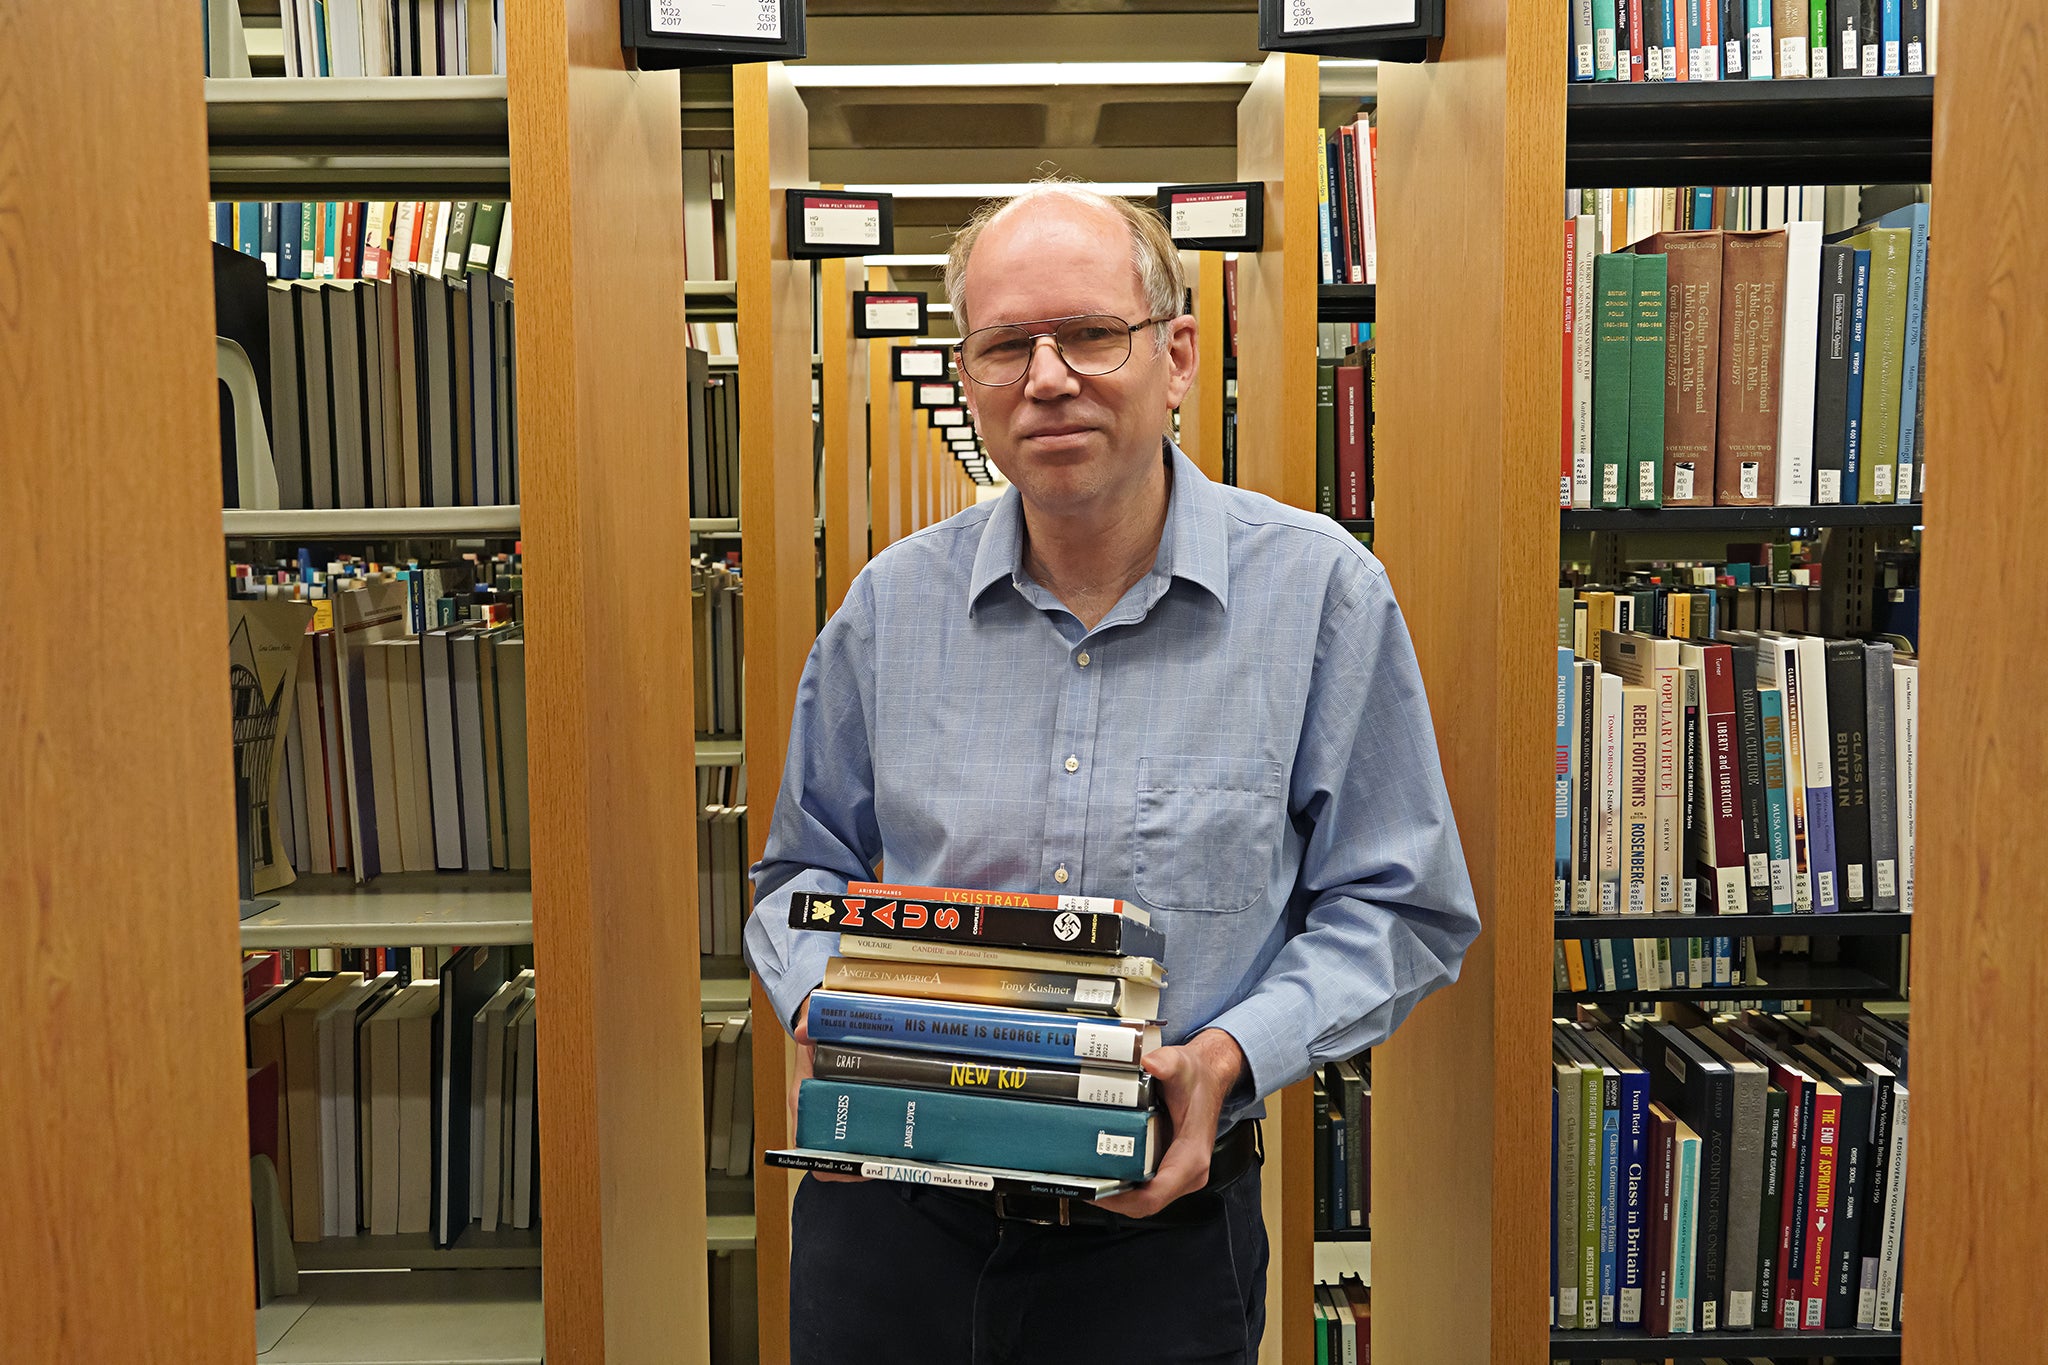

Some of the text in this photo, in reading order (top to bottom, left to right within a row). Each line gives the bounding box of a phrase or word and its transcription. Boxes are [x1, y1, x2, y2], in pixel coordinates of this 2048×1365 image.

[660, 8, 680, 16] M22
[661, 18, 682, 26] 2017
[756, 23, 777, 32] 2017
[758, 14, 777, 22] C58
[762, 6, 776, 14] W5
[1293, 8, 1312, 16] C36
[1293, 17, 1314, 26] 2012
[453, 212, 466, 236] SEX
[1916, 249, 1924, 276] Radical
[1669, 285, 1679, 342] Great Britain
[1734, 284, 1745, 342] Great Britain
[1682, 284, 1696, 392] Public Opinion Polls
[1696, 282, 1710, 414] The Gallup International
[1747, 284, 1762, 391] Public Opinion Polls
[1759, 281, 1775, 414] The Gallup International
[1558, 675, 1566, 727] PILKINGTON
[1662, 675, 1672, 736] POPULAR
[1632, 705, 1647, 807] REBEL FOOTPRINTS
[1742, 689, 1759, 786] RADICAL CULTURE
[1662, 740, 1672, 790] VIRTUE
[1716, 722, 1733, 818] LIBERTY and LIBERTICIDE
[1837, 733, 1850, 807] BRITAIN
[1852, 731, 1864, 805] CLASS IN
[1772, 803, 1781, 830] MUSA
[840, 899, 960, 930] MAUS
[944, 891, 1030, 908] LYSISTRATA
[858, 940, 892, 950] VOLTAIRE
[912, 945, 945, 954] CANDIDE
[958, 949, 981, 959] Related
[982, 951, 998, 960] Texts
[837, 964, 879, 979] ANGELS
[879, 972, 891, 980] IN
[893, 972, 942, 984] AMERICA
[1000, 980, 1025, 995] Tony
[1028, 982, 1071, 995] Kushner
[820, 1018, 894, 1032] TOLUSE OLORUNNIPA
[821, 1008, 882, 1020] ROBERT SAMUELS
[905, 1019, 1041, 1043] HIS NAME IS GEORGE
[836, 1054, 862, 1069] CRAFT
[950, 1062, 991, 1087] NEW
[835, 1095, 849, 1140] ULYSSES
[1589, 1081, 1597, 1130] GENTRIFICATION
[1632, 1091, 1641, 1134] Ivan Reid
[1881, 1085, 1889, 1111] Everyday
[904, 1101, 916, 1149] JAMES JOYCE
[778, 1157, 808, 1167] Richardson
[814, 1161, 833, 1169] Parnell
[840, 1163, 853, 1172] Cole
[866, 1167, 883, 1177] and
[884, 1166, 932, 1184] TANGO
[933, 1176, 962, 1186] makes
[964, 1177, 988, 1188] three
[1055, 1187, 1079, 1197] Schuster
[1710, 1130, 1722, 1208] ACCOUNTING
[1768, 1119, 1779, 1196] STRUCTURE DISADVANTAGE
[1892, 1137, 1902, 1192] REDISCOVERING
[1608, 1133, 1618, 1253] Class Contemporary Britain
[1812, 1109, 1835, 1287] THE END OF ASPIRATION? Duncan Exley
[1890, 1194, 1898, 1233] VOLUNTARY
[1627, 1163, 1642, 1284] Class in Britain
[1586, 1246, 1594, 1276] KIRSTEEN
